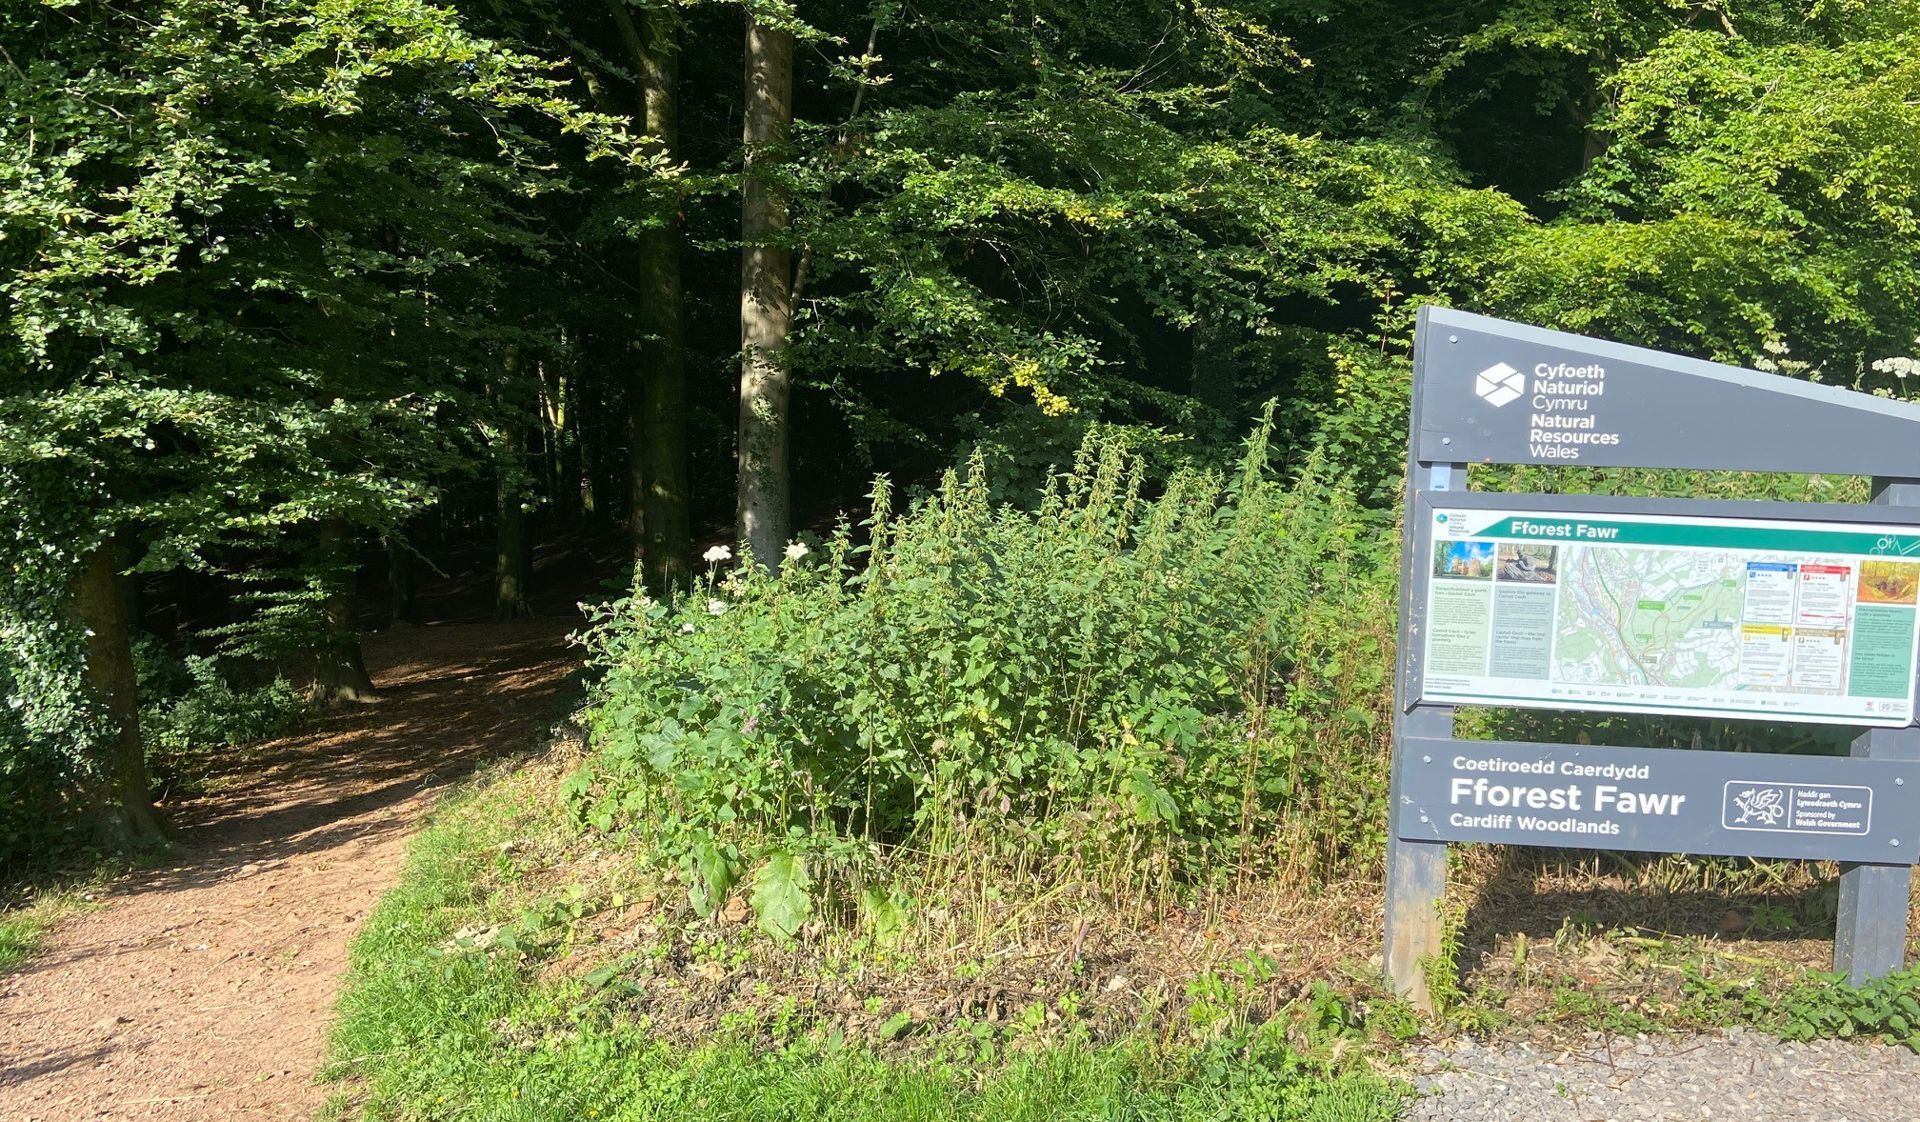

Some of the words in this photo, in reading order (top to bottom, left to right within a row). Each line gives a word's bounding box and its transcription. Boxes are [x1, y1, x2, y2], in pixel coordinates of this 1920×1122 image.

[1534, 363, 1605, 379] Cyfoeth
[1533, 380, 1604, 396] Naturiol
[1532, 395, 1587, 412] Cymru
[1531, 414, 1595, 429] Natural
[1530, 429, 1620, 445] Resources
[1529, 444, 1579, 459] Wales
[1511, 521, 1572, 537] Fforest
[1576, 524, 1619, 539] Fawr
[1452, 756, 1556, 775] Coetiroedd
[1560, 761, 1650, 781] Caerdydd
[1450, 778, 1582, 811] Fforest
[1594, 784, 1686, 816] Fawr
[1449, 812, 1513, 830] Cardiff
[1517, 816, 1621, 835] Woodlands
